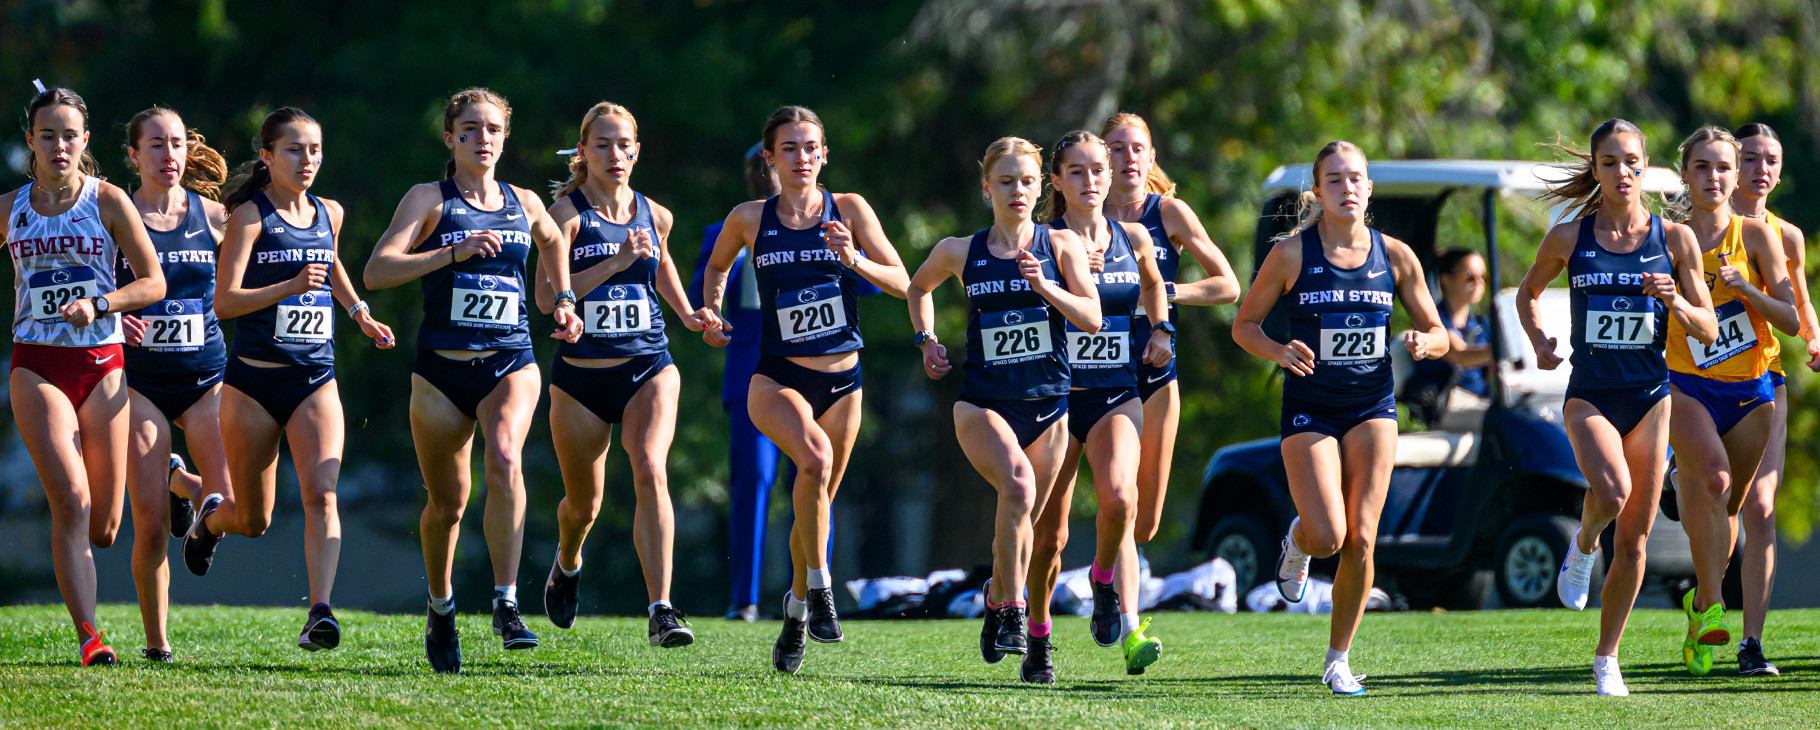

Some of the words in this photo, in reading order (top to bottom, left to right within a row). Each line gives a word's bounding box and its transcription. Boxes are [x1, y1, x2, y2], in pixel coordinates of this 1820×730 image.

[9, 236, 104, 260] TEMPLE
[441, 230, 482, 246] PE
[168, 250, 214, 263] STATE
[257, 249, 303, 263] PENN
[574, 243, 620, 260] PENN
[756, 251, 796, 268] PENN
[800, 249, 841, 262] STA
[966, 280, 1005, 297] PENN
[1572, 273, 1614, 288] PENN
[463, 293, 508, 320] 227
[1299, 290, 1345, 304] PENN
[1349, 290, 1393, 306] STATE
[287, 310, 324, 335] 222
[596, 304, 640, 329] 219
[790, 303, 835, 335] 220
[1597, 315, 1644, 341] 217
[153, 319, 192, 343] 221
[994, 326, 1040, 356] 226
[1077, 336, 1121, 361] 225
[1332, 332, 1375, 357] 223
